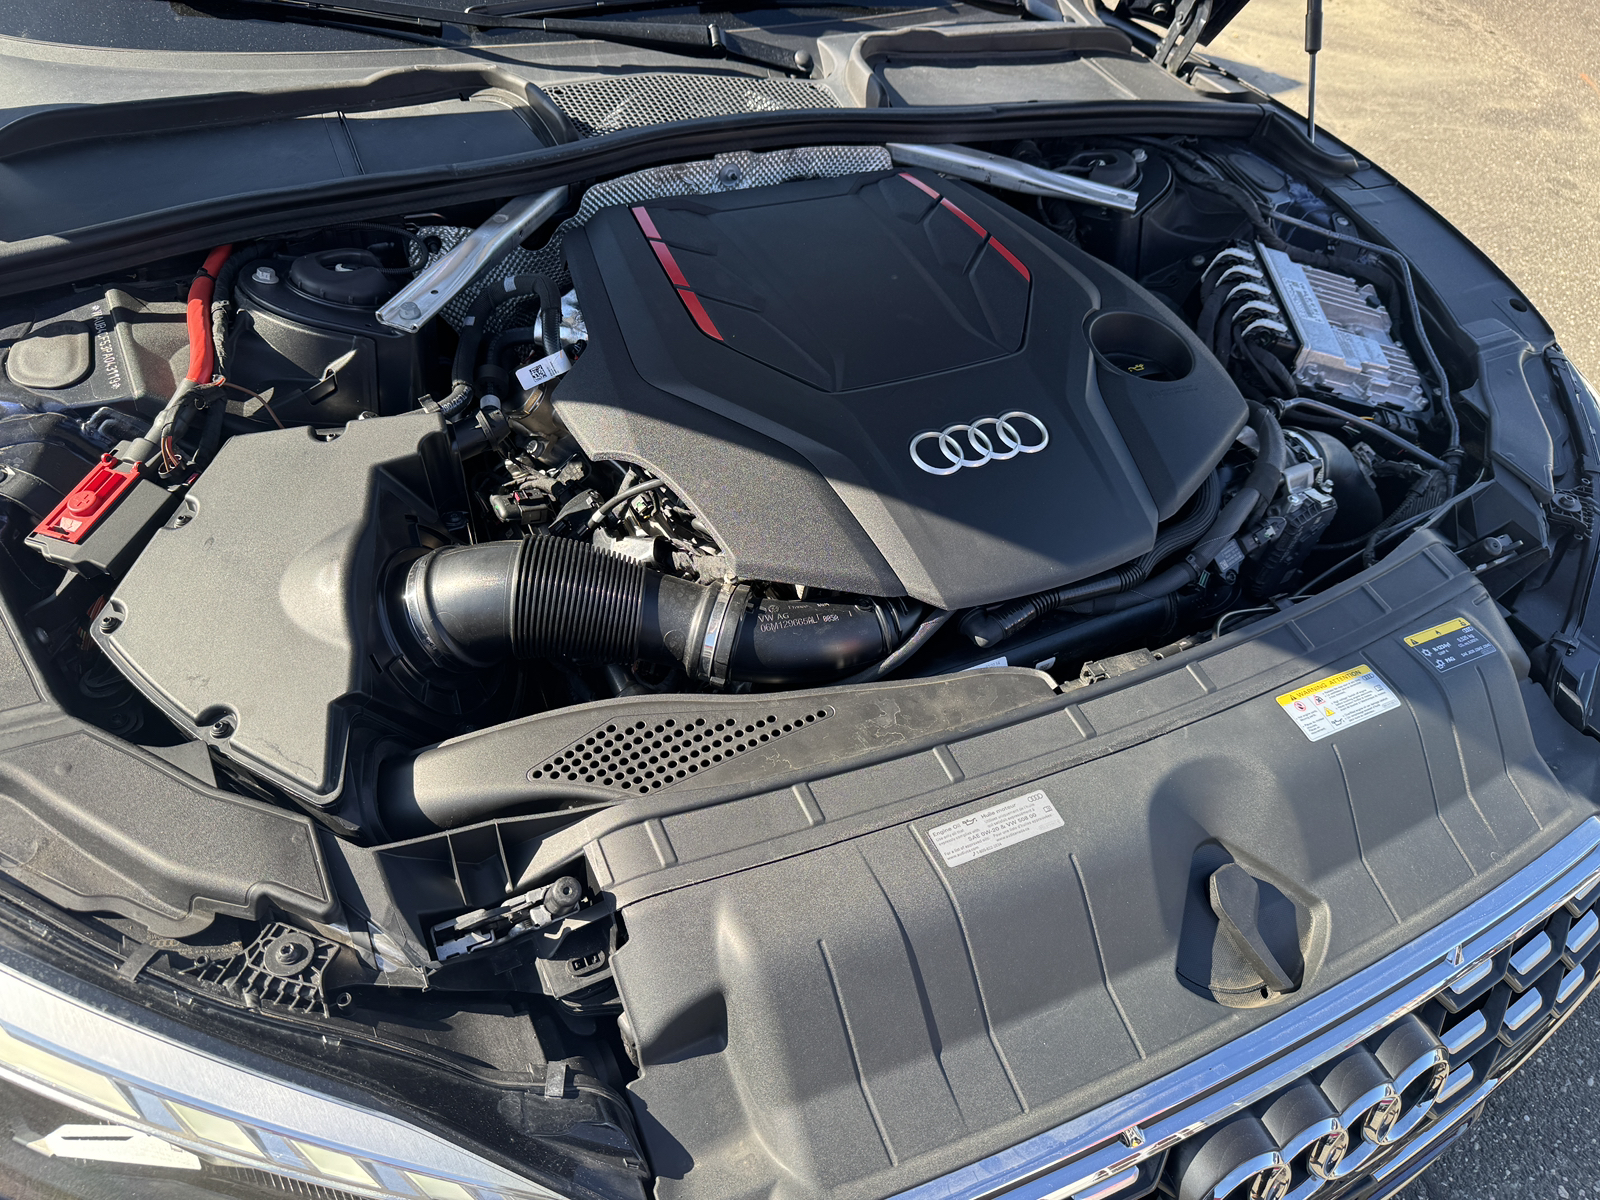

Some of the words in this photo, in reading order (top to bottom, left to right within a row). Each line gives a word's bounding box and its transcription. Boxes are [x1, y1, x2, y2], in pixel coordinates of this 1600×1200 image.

[758, 615, 774, 623] VW
[777, 612, 790, 621] AG
[1296, 683, 1327, 698] WARNING
[1328, 669, 1361, 685] ATTENTION
[981, 811, 995, 819] Huile
[996, 803, 1017, 813] moteur
[932, 827, 952, 837] Engine
[981, 827, 1000, 836] 0W-20
